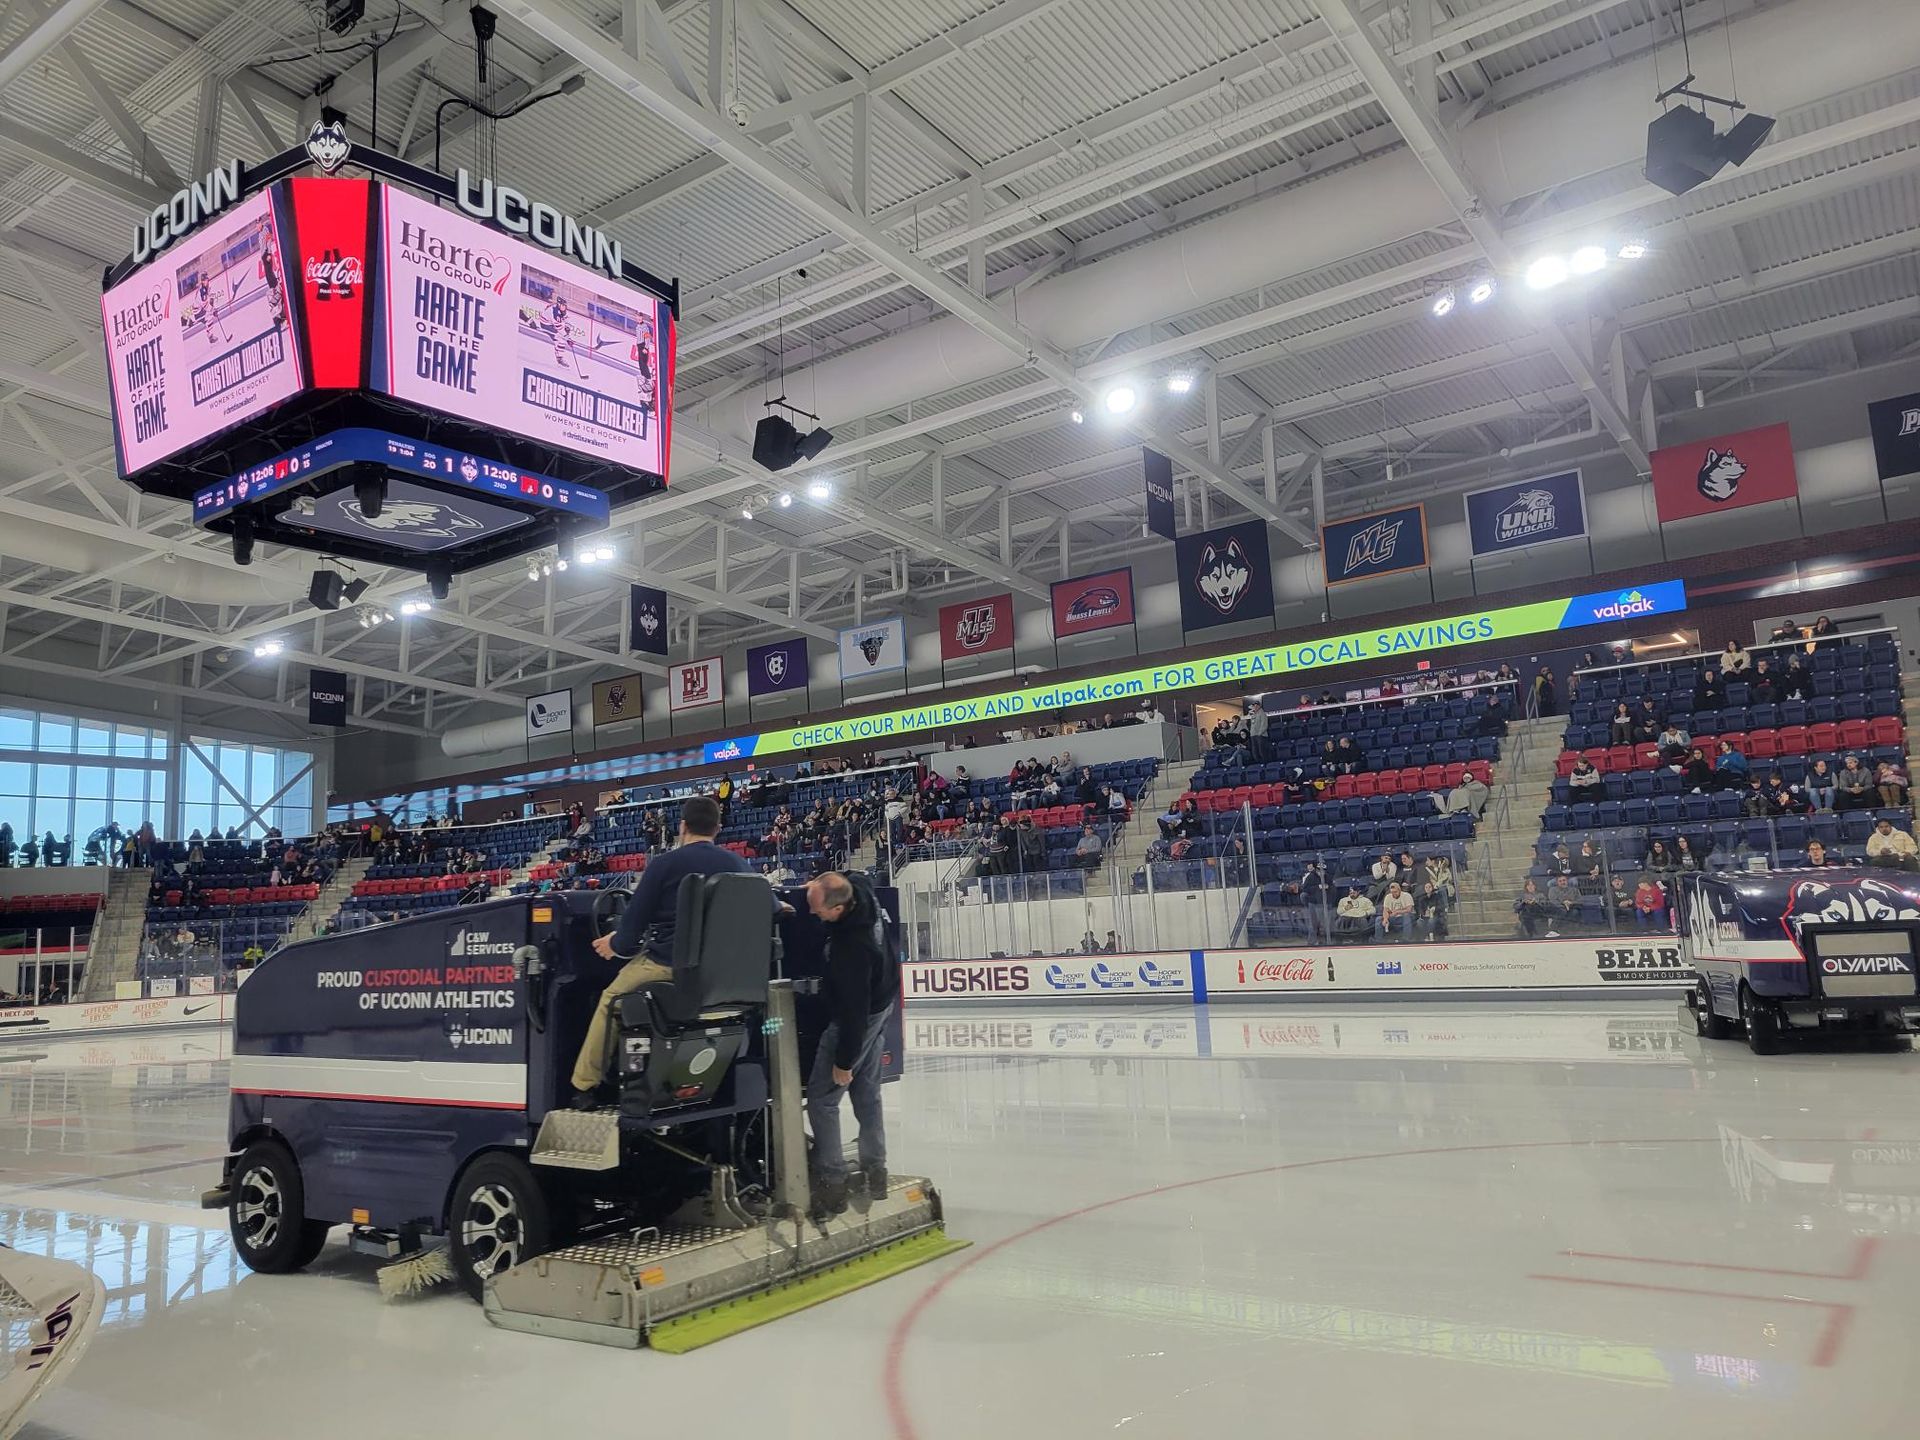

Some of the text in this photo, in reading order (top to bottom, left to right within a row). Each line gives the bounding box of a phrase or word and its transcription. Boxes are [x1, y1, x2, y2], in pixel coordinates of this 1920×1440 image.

[133, 160, 241, 264] UCONN
[455, 168, 622, 279] UCONN
[400, 220, 493, 278] Harte
[306, 256, 364, 285] Coca-Cola
[401, 249, 492, 291] AUTO GROUP
[112, 291, 163, 337] Harte
[414, 275, 486, 340] HARTE
[116, 314, 163, 349] AUTO GROUP
[416, 321, 480, 352] OF THE
[126, 335, 166, 393] HARTE
[193, 331, 281, 402] CHRISTINA WALKER
[416, 335, 478, 395] GAME
[131, 377, 165, 404] OF THE
[134, 391, 168, 444] GAME
[527, 374, 645, 437] CHRISTINA WALKER
[544, 412, 627, 444] WOMEN'S ICE HOCKEY
[251, 458, 299, 483] 12:06 0
[423, 457, 453, 472] 20 1
[228, 485, 233, 499] 1
[483, 464, 553, 498] 12:06 0
[493, 481, 507, 490] 2ND
[1147, 481, 1173, 502] UCONN
[559, 495, 568, 503] 15
[1501, 521, 1553, 539] WILDCATS
[1502, 507, 1553, 530] UNH
[1593, 597, 1654, 620] valpak
[682, 665, 709, 697] BU
[713, 616, 1494, 760] valpak CHECK YOUR MAILBOX AND valpak.com FOR GREAT LOCAL SAVINGS
[313, 691, 344, 702] UCONN
[547, 709, 567, 718] HOCKEY
[466, 931, 490, 944] C&W
[466, 943, 515, 955] SERVICES
[317, 965, 515, 988] PROUD CUSTODIAL PARTNER
[1253, 957, 1317, 982] Coca-Cola
[1376, 960, 1402, 971] CBS
[1419, 962, 1450, 971] xerox
[1453, 963, 1479, 971] Business
[1479, 963, 1506, 971] Solutions
[1507, 963, 1536, 971] Company
[1616, 971, 1689, 980] SMOKEHOUSE
[1823, 956, 1910, 973] OLYMPIA
[912, 964, 1029, 993] HUSKIES
[359, 989, 515, 1010] OF UCONN ATHLETICS
[5, 1010, 20, 1018] NEXT
[465, 1028, 512, 1046] UCONN
